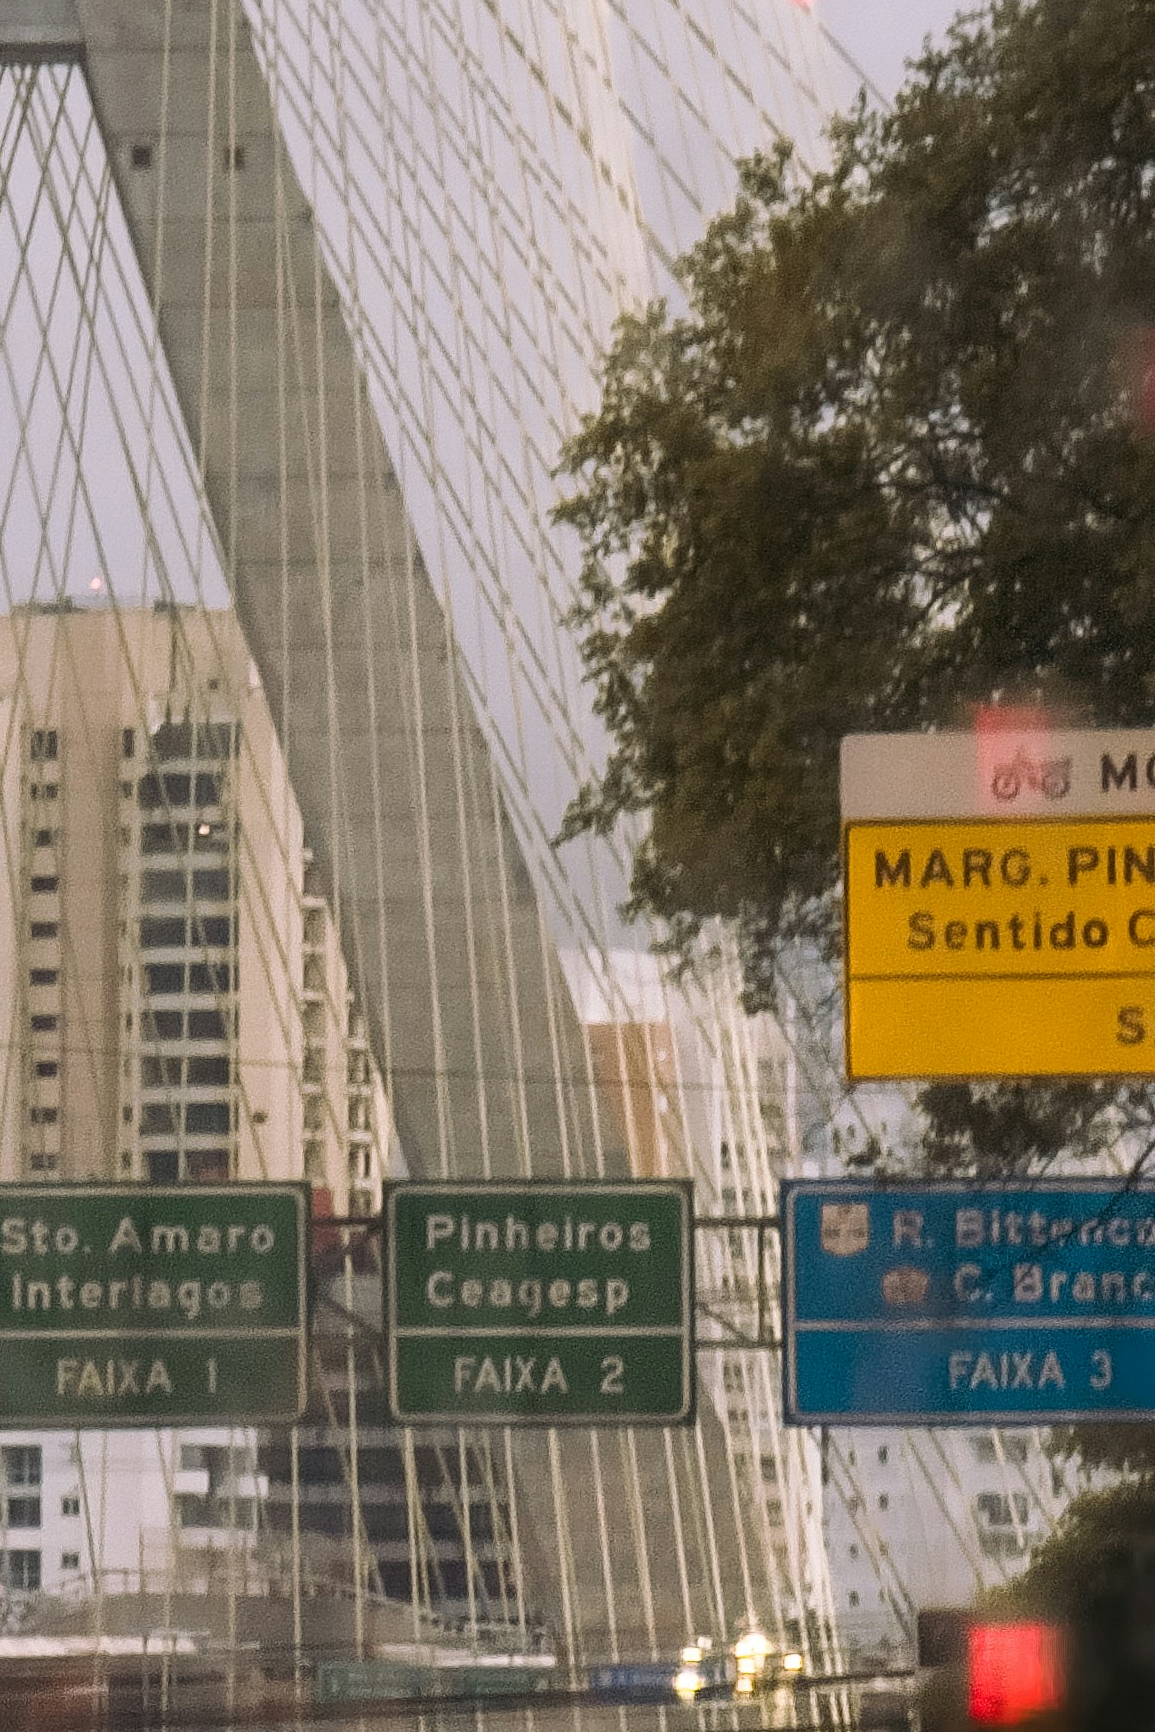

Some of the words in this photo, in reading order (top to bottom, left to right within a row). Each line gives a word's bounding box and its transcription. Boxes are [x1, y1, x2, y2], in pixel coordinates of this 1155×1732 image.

[1101, 752, 1155, 792] M
[873, 847, 1047, 889] MARG.
[1067, 845, 1155, 886] PIN
[907, 909, 1109, 952] Sentido
[0, 1216, 92, 1257] Sto.
[109, 1215, 276, 1255] Amaro
[425, 1214, 652, 1252] Pinheiros
[892, 1210, 936, 1249] R.
[10, 1272, 264, 1320] Interlagos
[426, 1269, 631, 1319] Ceagesp
[953, 1263, 995, 1303] C.
[56, 1357, 173, 1397] FAIXA
[206, 1357, 219, 1395] 1
[453, 1355, 570, 1395] FAIXA
[599, 1353, 627, 1395] 2
[949, 1349, 1066, 1391] FAIXA
[1089, 1348, 1113, 1392] 3
